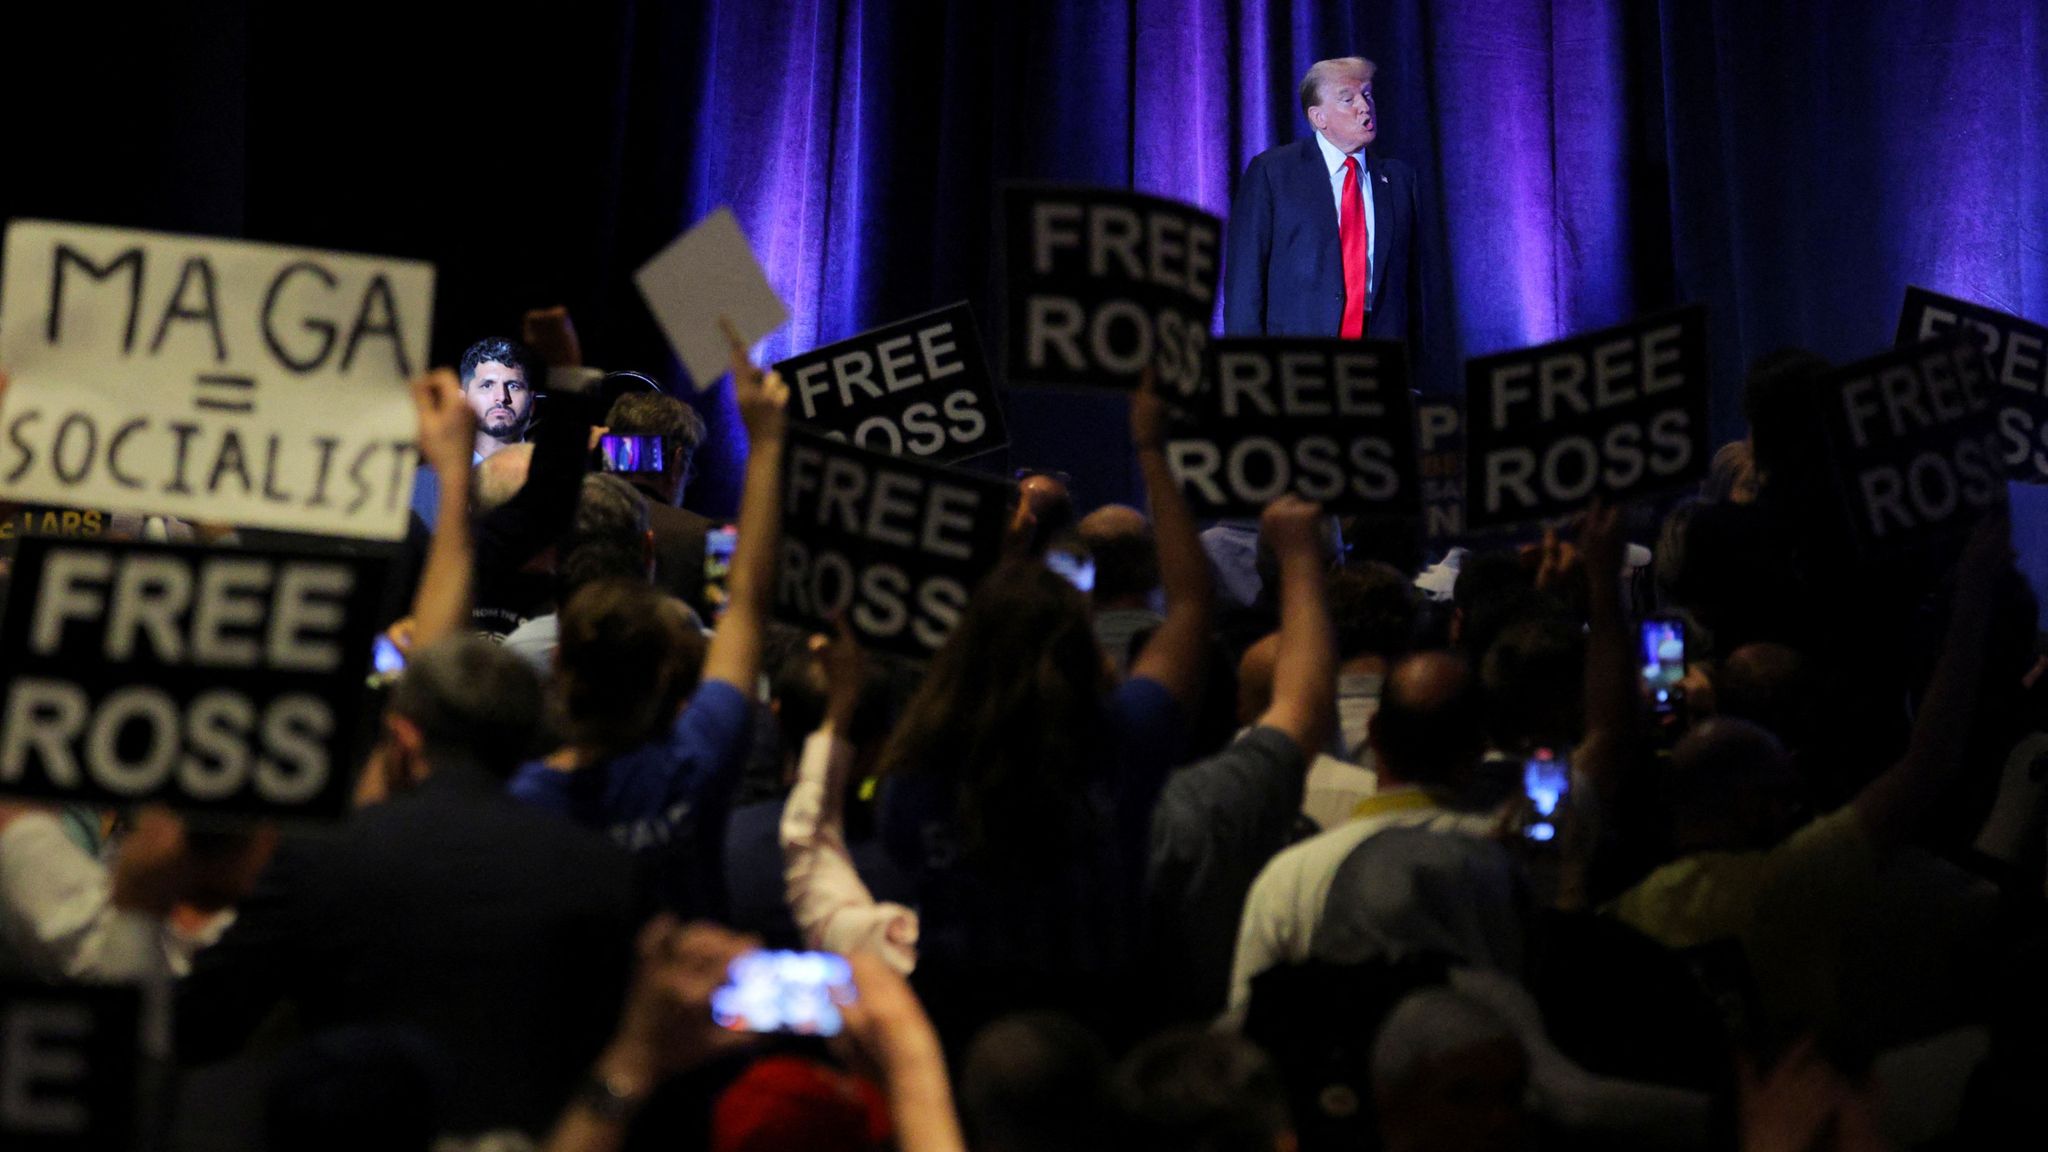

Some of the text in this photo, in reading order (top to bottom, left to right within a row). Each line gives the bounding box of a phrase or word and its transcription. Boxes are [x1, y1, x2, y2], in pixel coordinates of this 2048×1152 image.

[1030, 200, 1219, 305] FREE
[47, 244, 412, 378] MAGA
[1917, 304, 2048, 399] FRE
[795, 321, 967, 420] FREE
[826, 387, 987, 457] OSS
[1216, 350, 1387, 418] REE
[1488, 322, 1688, 433] FREE
[1841, 342, 1991, 449] FREE
[5, 409, 420, 514] SOCIALIST
[785, 445, 982, 562] FREE
[1165, 433, 1401, 507] ROSS
[1484, 406, 1695, 514] ROSS
[26, 545, 360, 675] FREE
[774, 534, 972, 650] ROSS
[0, 673, 338, 808] ROSS
